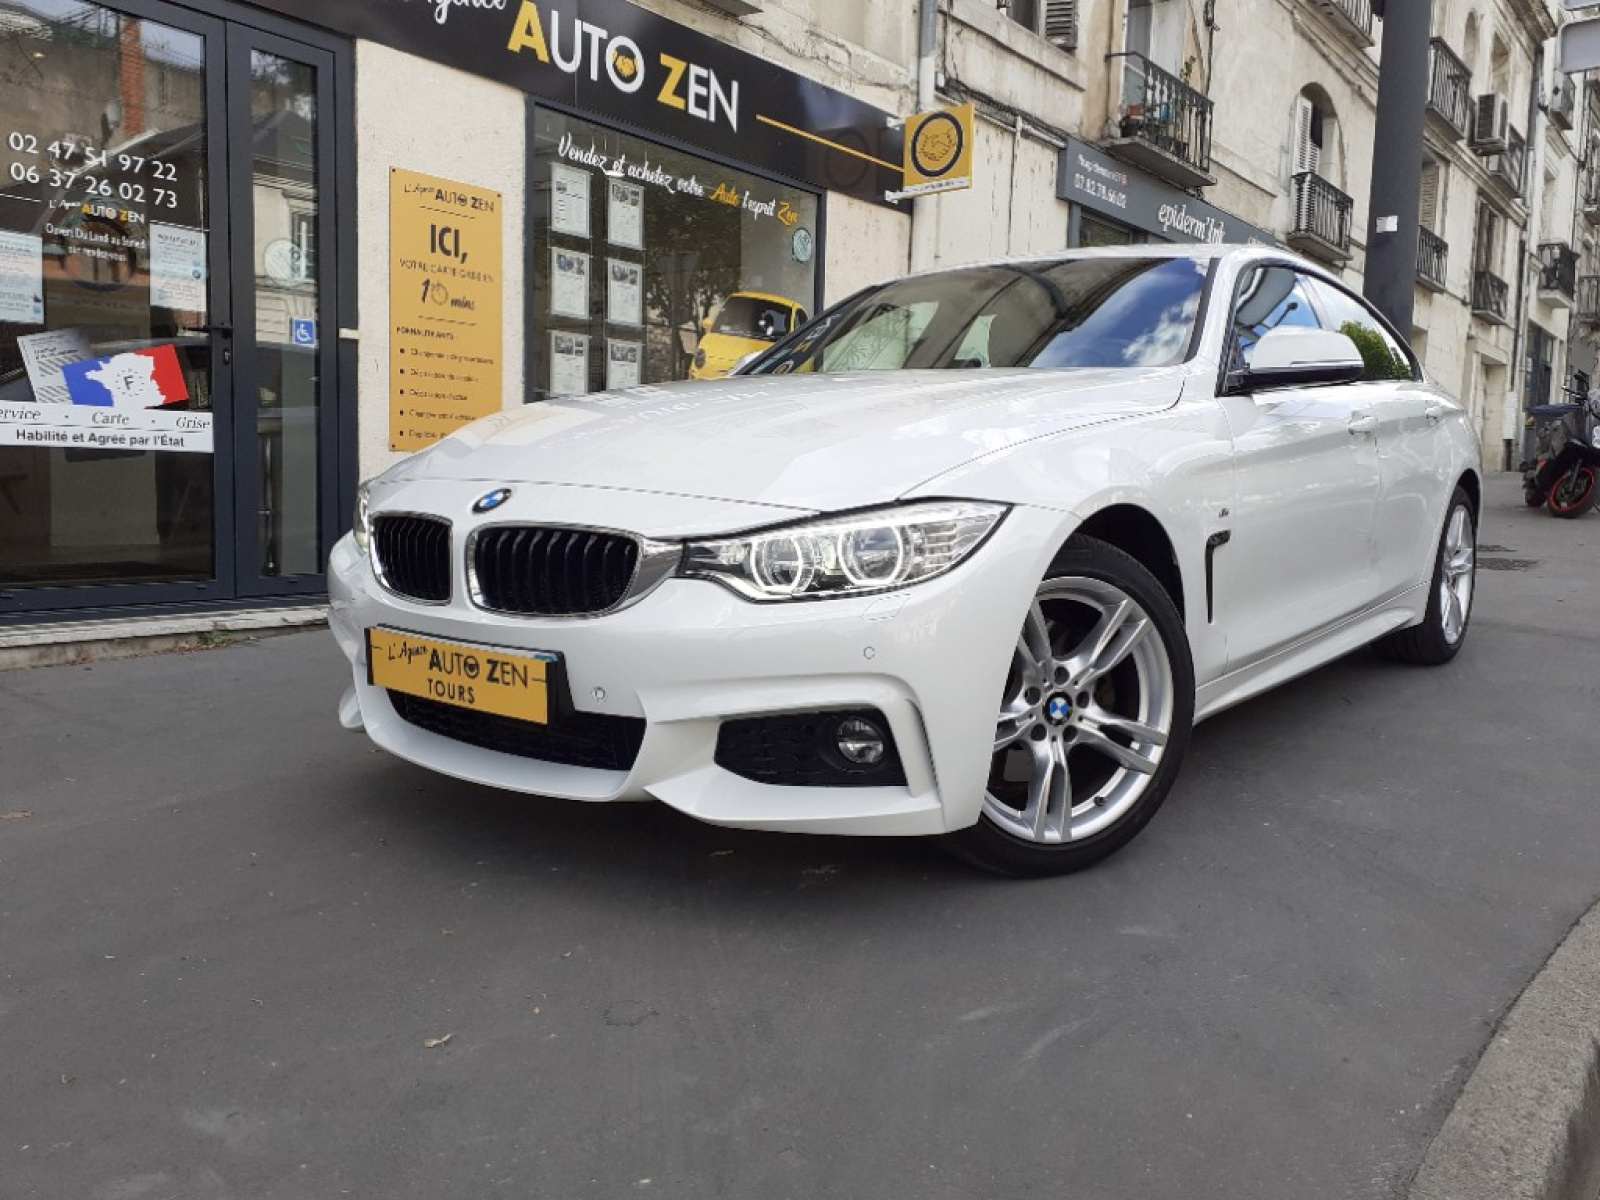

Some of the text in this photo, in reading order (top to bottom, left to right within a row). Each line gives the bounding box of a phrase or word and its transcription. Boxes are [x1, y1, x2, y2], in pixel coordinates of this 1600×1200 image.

[507, 0, 645, 94] AUTO
[657, 53, 739, 133] ZEN
[9, 131, 178, 182] 02 47 51 97 22
[10, 162, 178, 209] 06 37 26 02 73
[558, 131, 616, 175] Vendez
[612, 153, 627, 174] et
[628, 158, 675, 194] achetez
[709, 182, 740, 206] Auto
[777, 201, 799, 226] Zen
[81, 204, 116, 219] AUTO
[120, 210, 145, 223] ZEN
[435, 189, 468, 206] AUTO
[470, 196, 495, 213] ZEN
[431, 223, 468, 264] ICI,
[16, 429, 185, 448] Habilité et Agréé par l'État
[92, 411, 130, 426] Carte
[176, 416, 210, 429] Grise
[429, 648, 480, 679] AUTO
[486, 658, 528, 689] ZEN
[428, 677, 475, 704] TOURS
